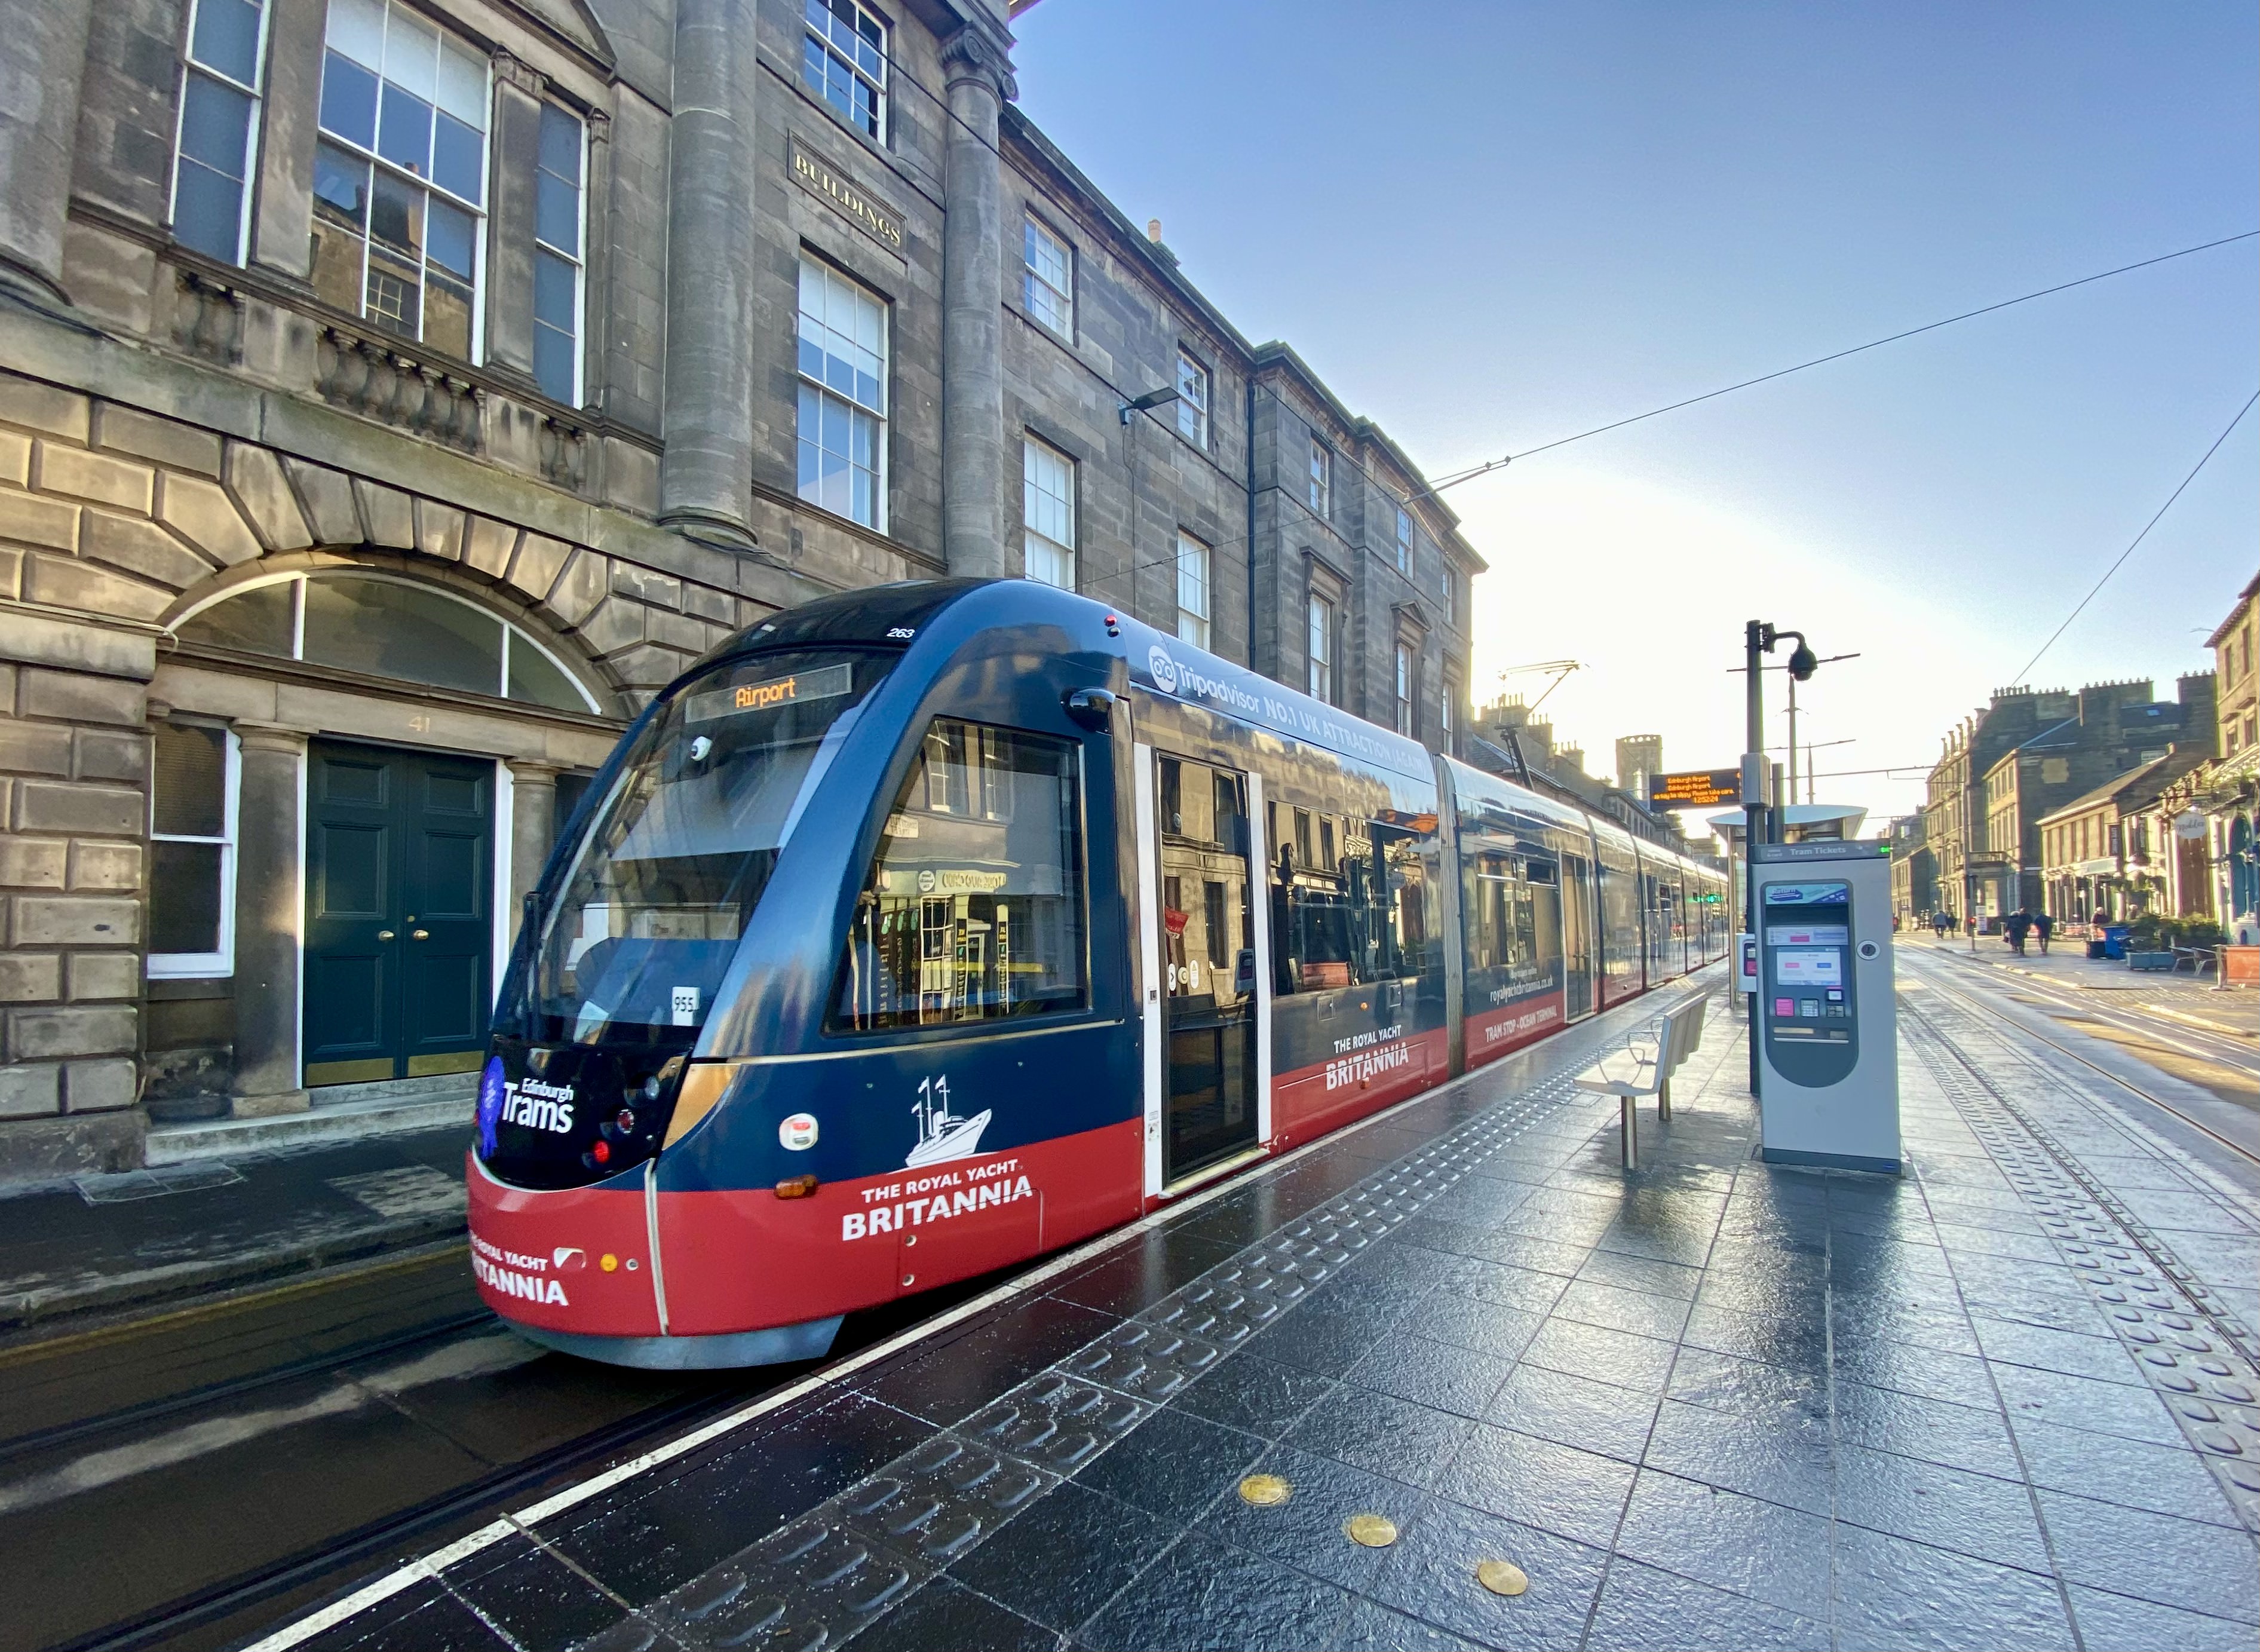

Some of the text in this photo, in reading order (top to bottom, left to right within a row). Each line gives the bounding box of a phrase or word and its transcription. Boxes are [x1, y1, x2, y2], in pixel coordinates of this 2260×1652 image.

[795, 153, 901, 246] BUILDINGS
[887, 628, 915, 638] 263
[735, 678, 795, 708] Airport
[409, 716, 430, 733] 41
[1175, 661, 1259, 714] Tripadvisor
[1263, 696, 1298, 727] NO.1
[1299, 710, 1321, 736] UK
[1323, 719, 1391, 762] ATTRACTION
[1667, 776, 1692, 784] Edinburgh
[675, 997, 694, 1012] 955
[1334, 1024, 1402, 1053] THE ROYAL YACHT
[1485, 1023, 1503, 1043] TRAM
[1503, 1019, 1516, 1036] STOP
[1519, 1012, 1537, 1029] OCEAN
[1326, 1041, 1409, 1090] BRITANNIA
[522, 1077, 574, 1102] Edinburgh
[502, 1081, 574, 1133] Trams
[861, 1158, 1018, 1203] THE ROYAL YACHT
[842, 1175, 1034, 1242] BRITANNIA
[504, 1251, 548, 1272] YACHT
